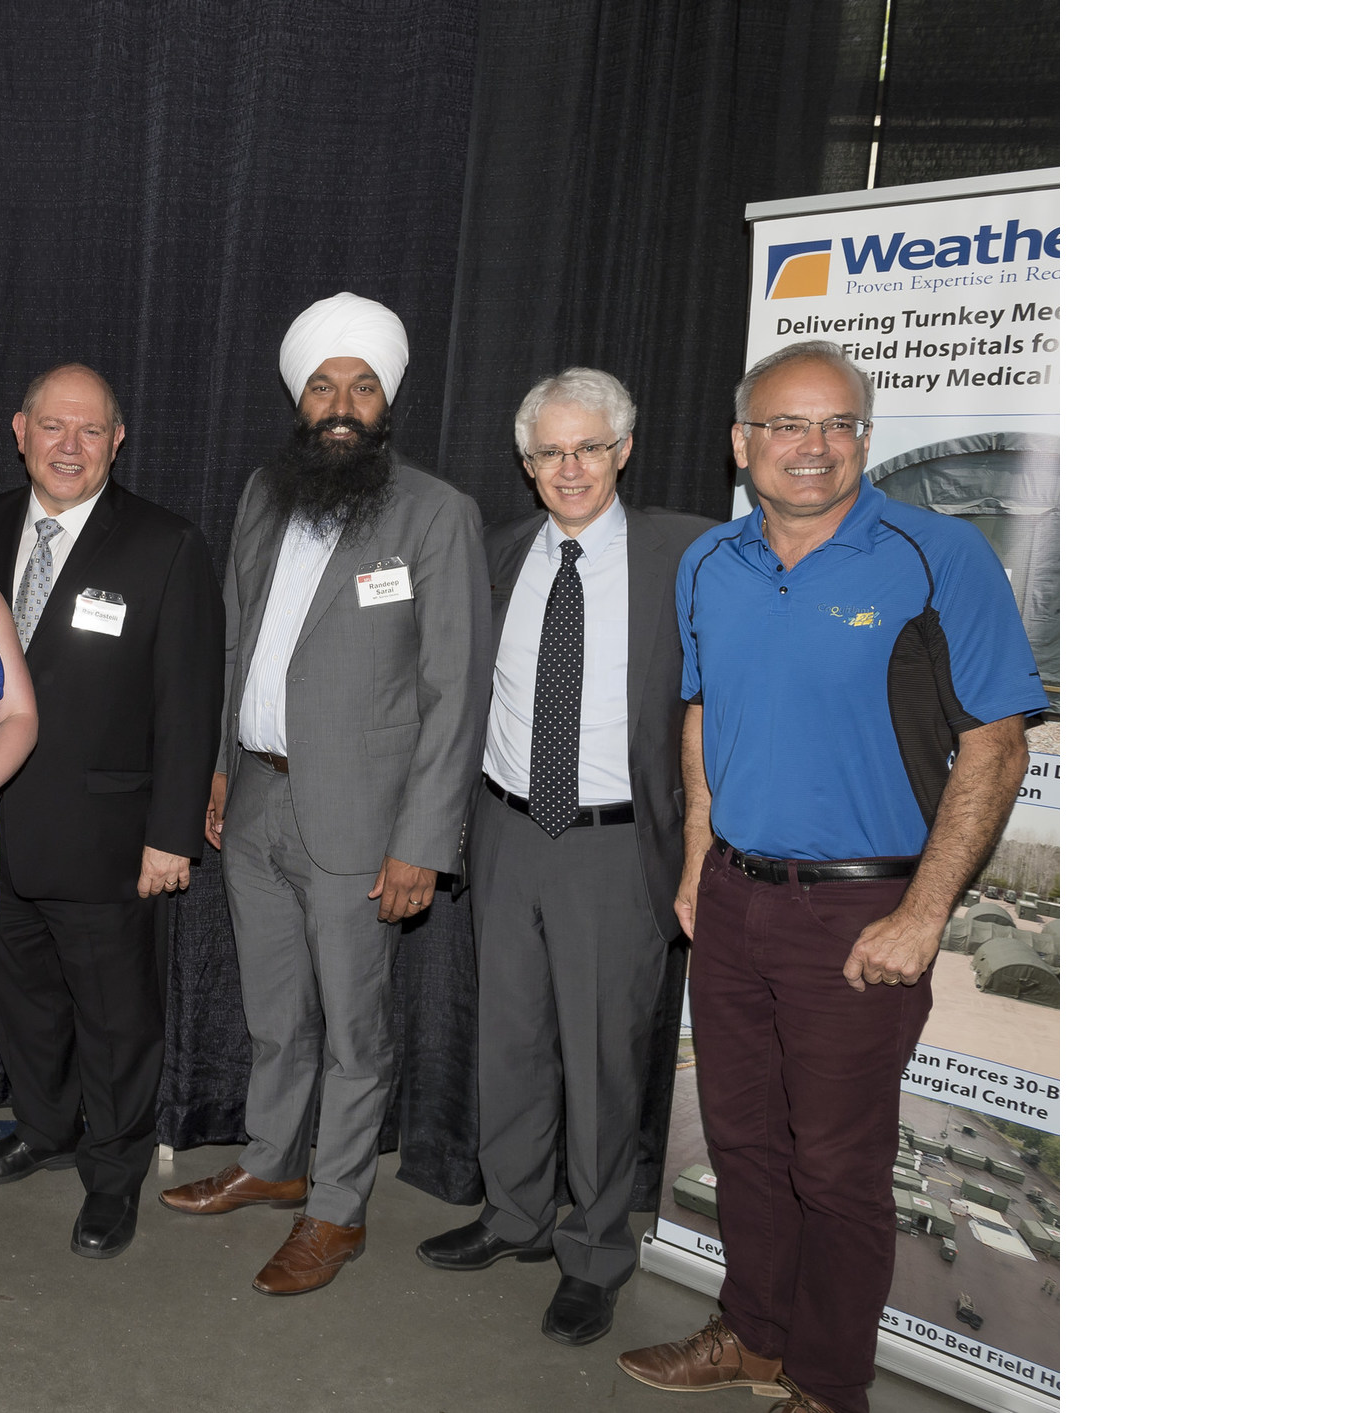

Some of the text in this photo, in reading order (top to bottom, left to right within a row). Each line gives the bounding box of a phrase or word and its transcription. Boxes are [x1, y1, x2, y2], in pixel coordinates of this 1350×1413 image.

[846, 279, 903, 295] Proven
[910, 271, 993, 293] Expertise
[999, 269, 1017, 284] in
[776, 312, 895, 336] Delivering
[901, 305, 1006, 330] Turnkey
[842, 332, 1060, 362] Field Hospitals fo
[869, 364, 1051, 393] ilitary Medical
[369, 580, 399, 590] Randeep
[376, 587, 394, 596] Sarai
[1025, 762, 1049, 777] al
[946, 1057, 1008, 1086] Forces
[1013, 1076, 1060, 1100] 30-B
[900, 1067, 1049, 1120] Surgical Centre
[905, 1319, 982, 1359] 100-Bed
[986, 1350, 1035, 1380] Field
